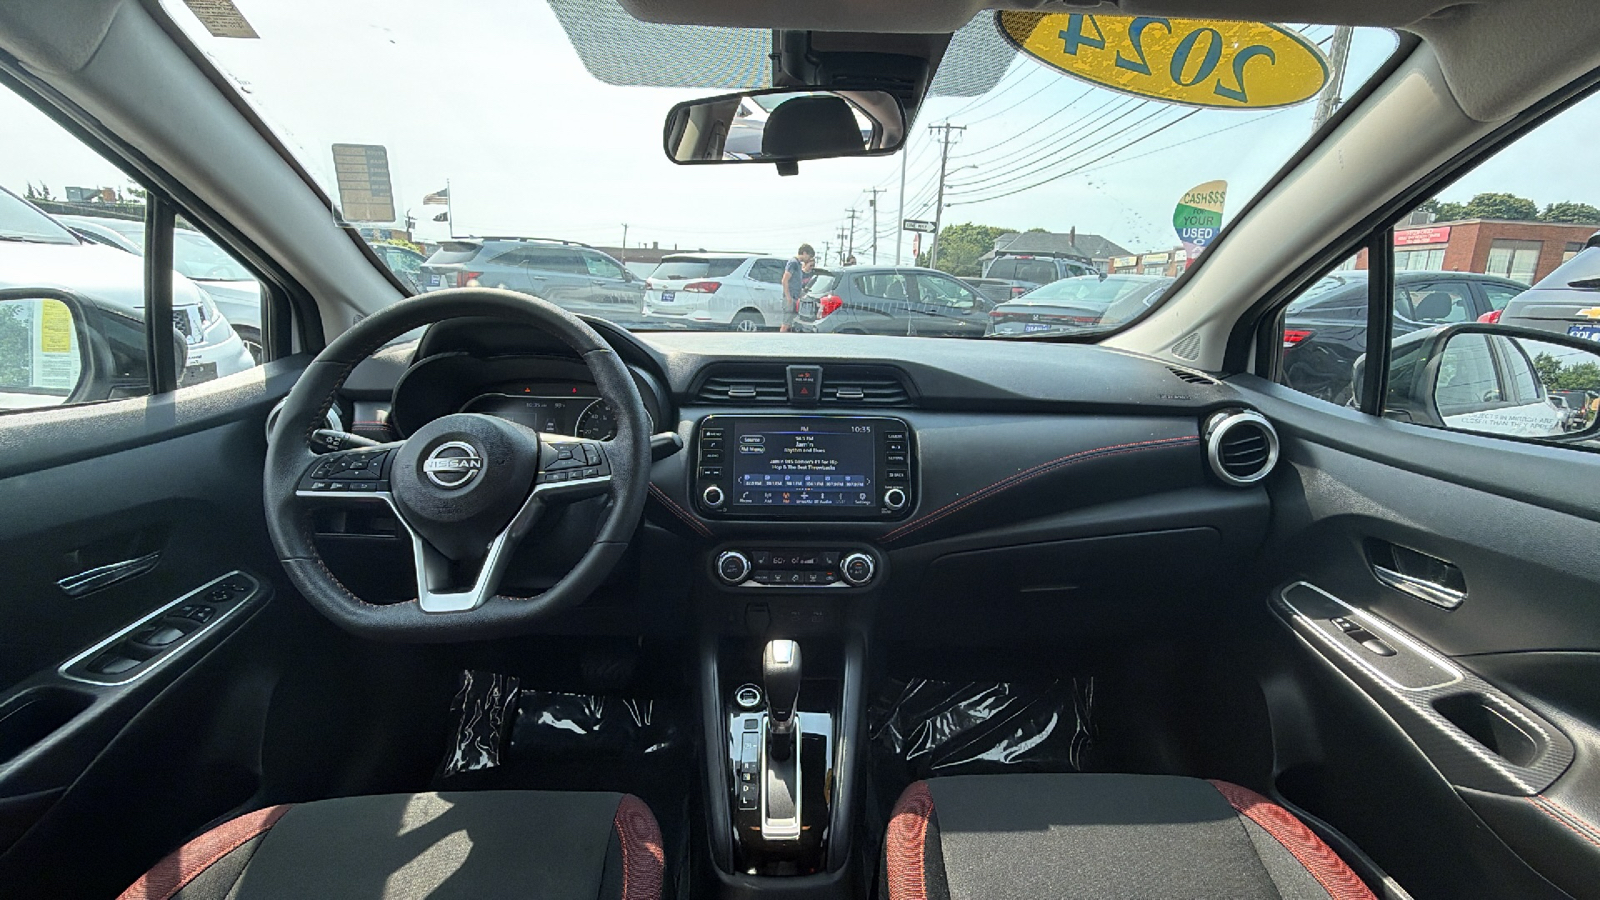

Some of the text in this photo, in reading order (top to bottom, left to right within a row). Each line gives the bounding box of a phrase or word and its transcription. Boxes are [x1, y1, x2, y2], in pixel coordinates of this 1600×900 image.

[1184, 191, 1225, 206] CASH$$$
[1184, 216, 1213, 225] YOUR
[1183, 228, 1212, 238] USED
[427, 459, 481, 468] NISSAN
